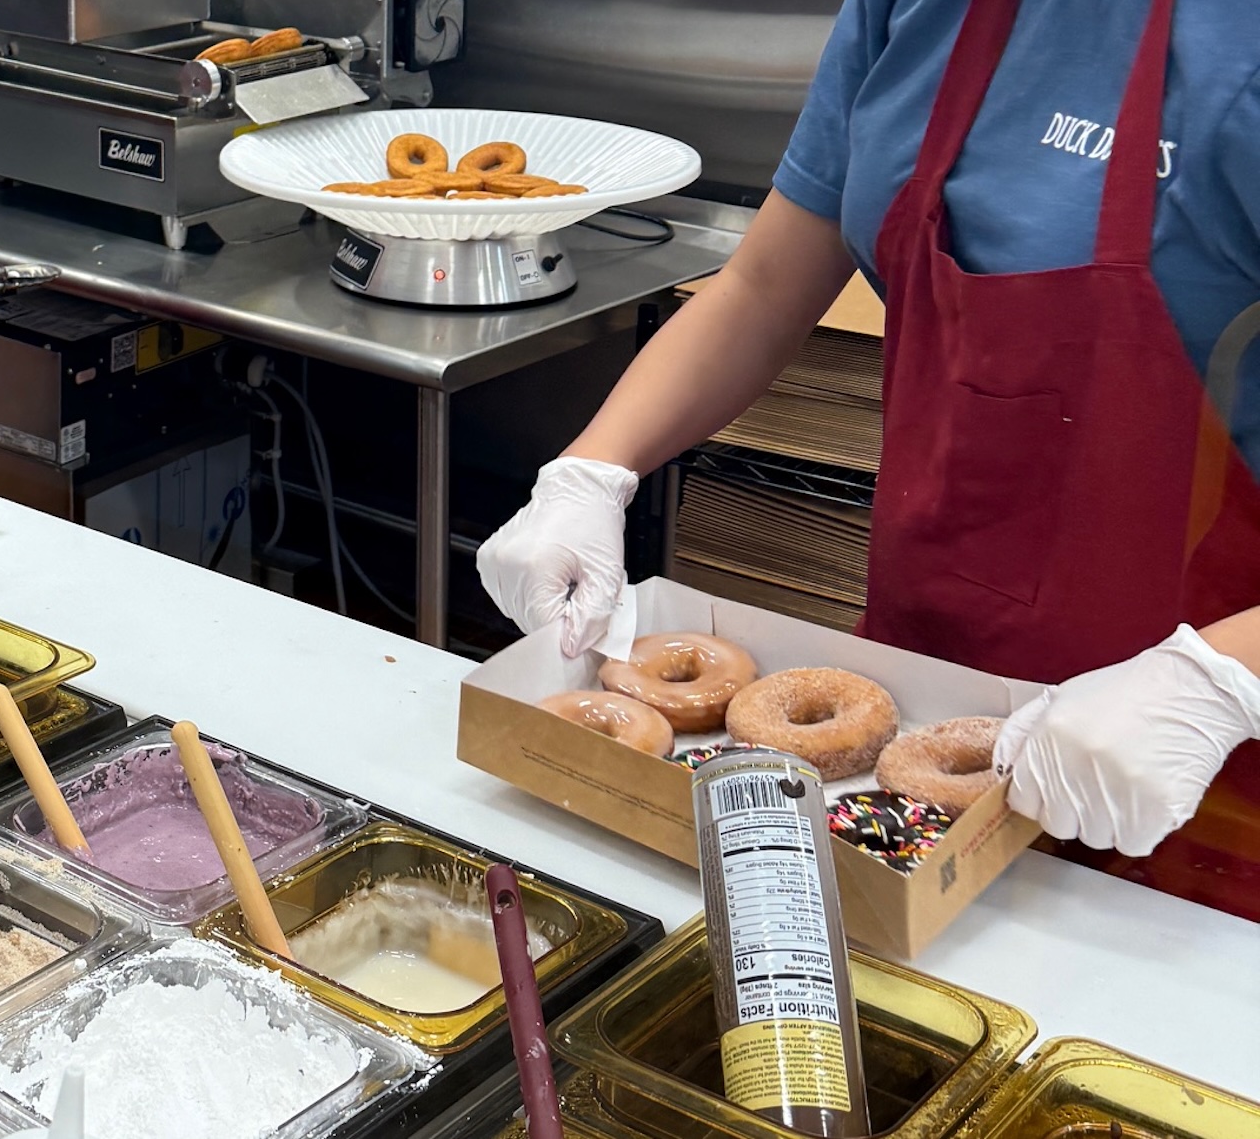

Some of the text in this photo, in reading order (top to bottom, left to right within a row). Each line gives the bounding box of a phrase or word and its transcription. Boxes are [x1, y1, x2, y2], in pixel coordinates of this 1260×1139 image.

[1041, 112, 1101, 156] DUCK
[107, 139, 156, 167] Belshaw
[735, 954, 830, 972] Calories 130
[740, 1002, 836, 1021] Nutrition Facts
